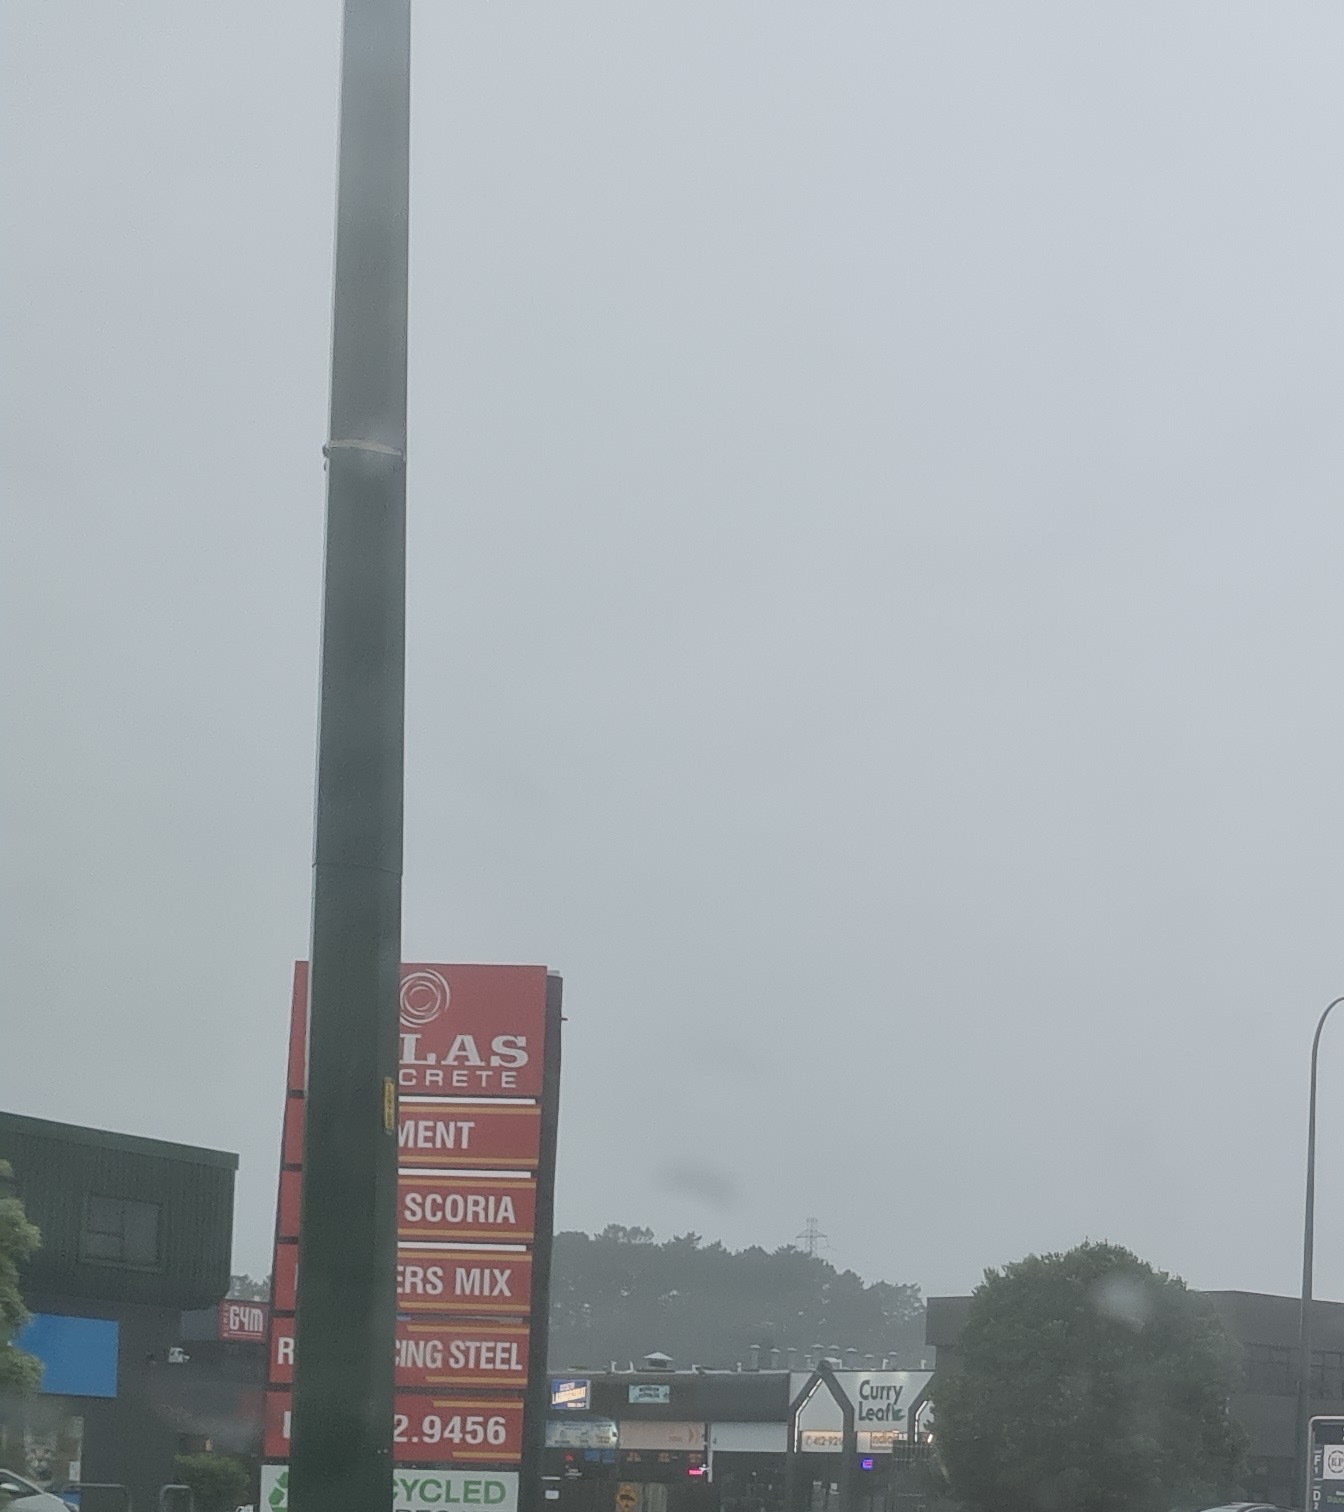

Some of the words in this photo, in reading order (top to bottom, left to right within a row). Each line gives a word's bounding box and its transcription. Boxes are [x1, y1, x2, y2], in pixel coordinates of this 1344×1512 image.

[399, 1033, 529, 1068] LAS
[398, 1069, 518, 1088] CRETE
[398, 1120, 475, 1149] MENT
[403, 1193, 516, 1224] SCORIA
[454, 1267, 512, 1297] MIX
[449, 1340, 523, 1370] STEEL
[859, 1379, 904, 1406] Curry
[393, 1413, 507, 1445] 2.9456
